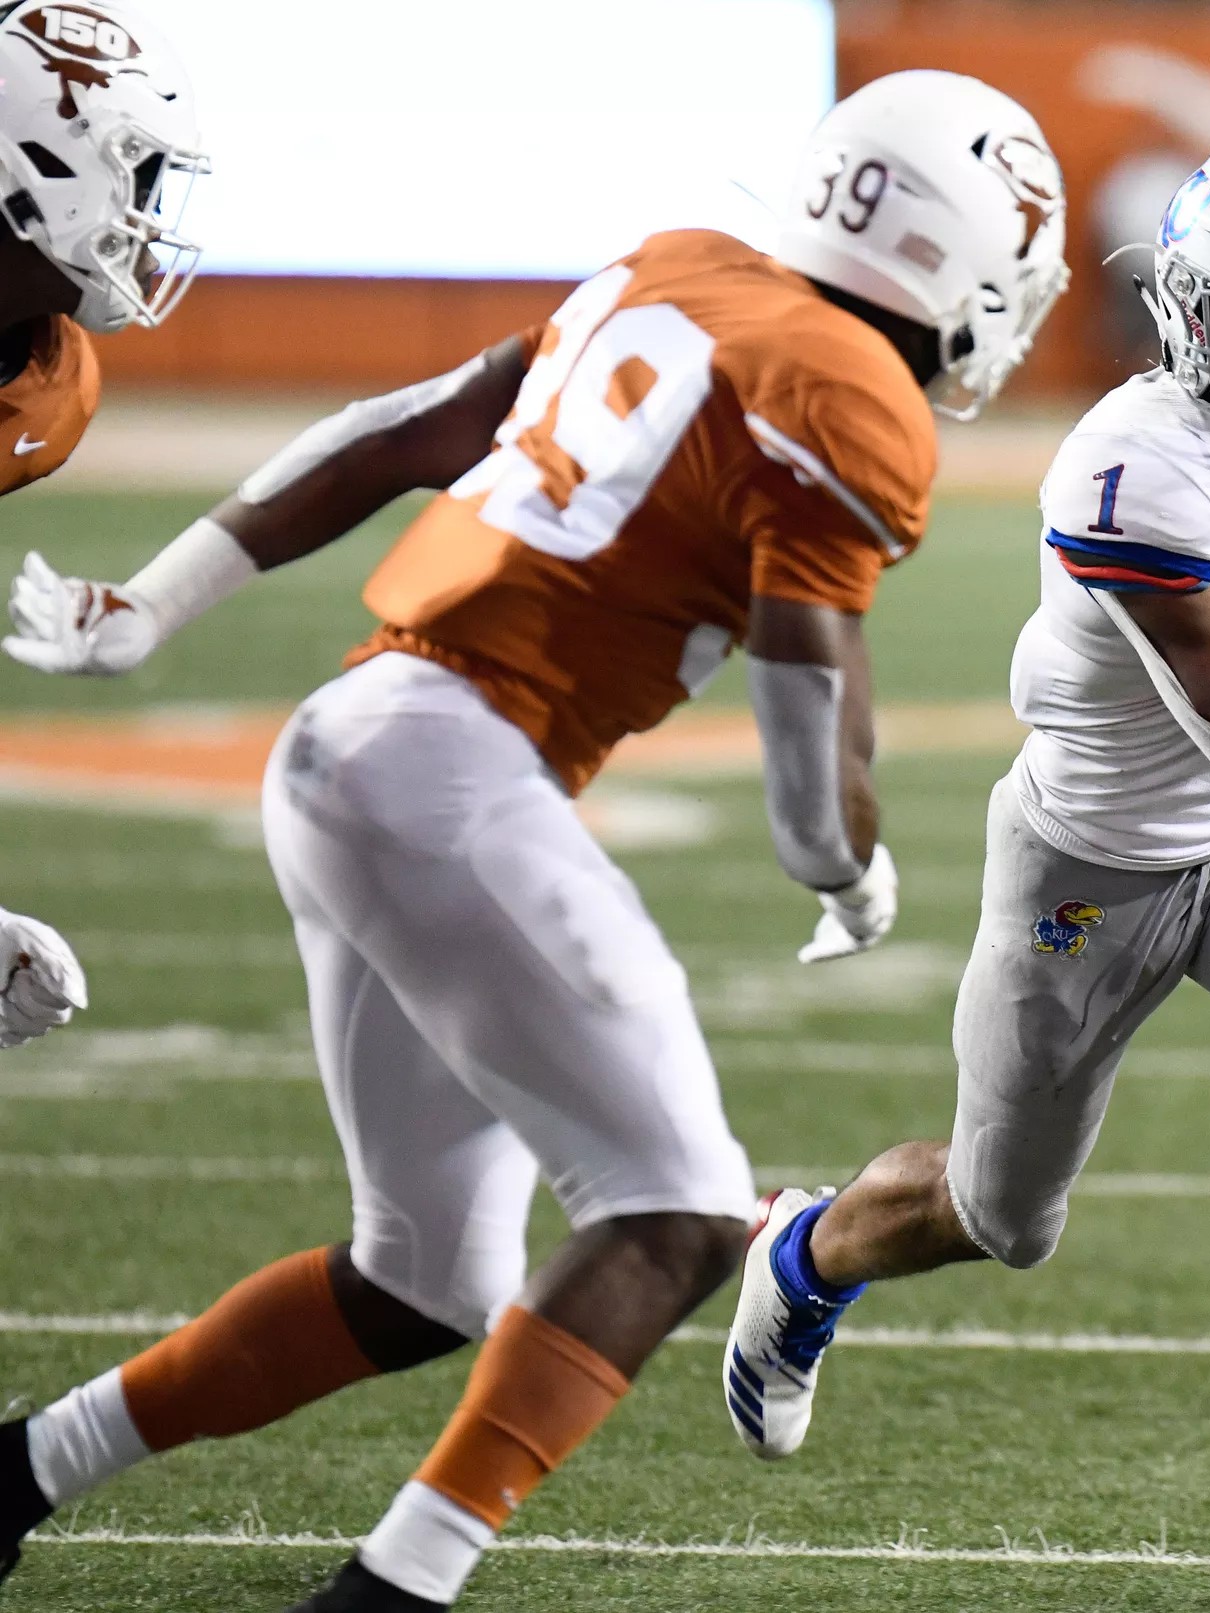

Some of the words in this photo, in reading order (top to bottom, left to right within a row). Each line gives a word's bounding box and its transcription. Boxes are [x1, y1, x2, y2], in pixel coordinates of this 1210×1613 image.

[41, 7, 130, 60] 150
[1088, 464, 1125, 536] 1
[1052, 928, 1070, 942] KU
